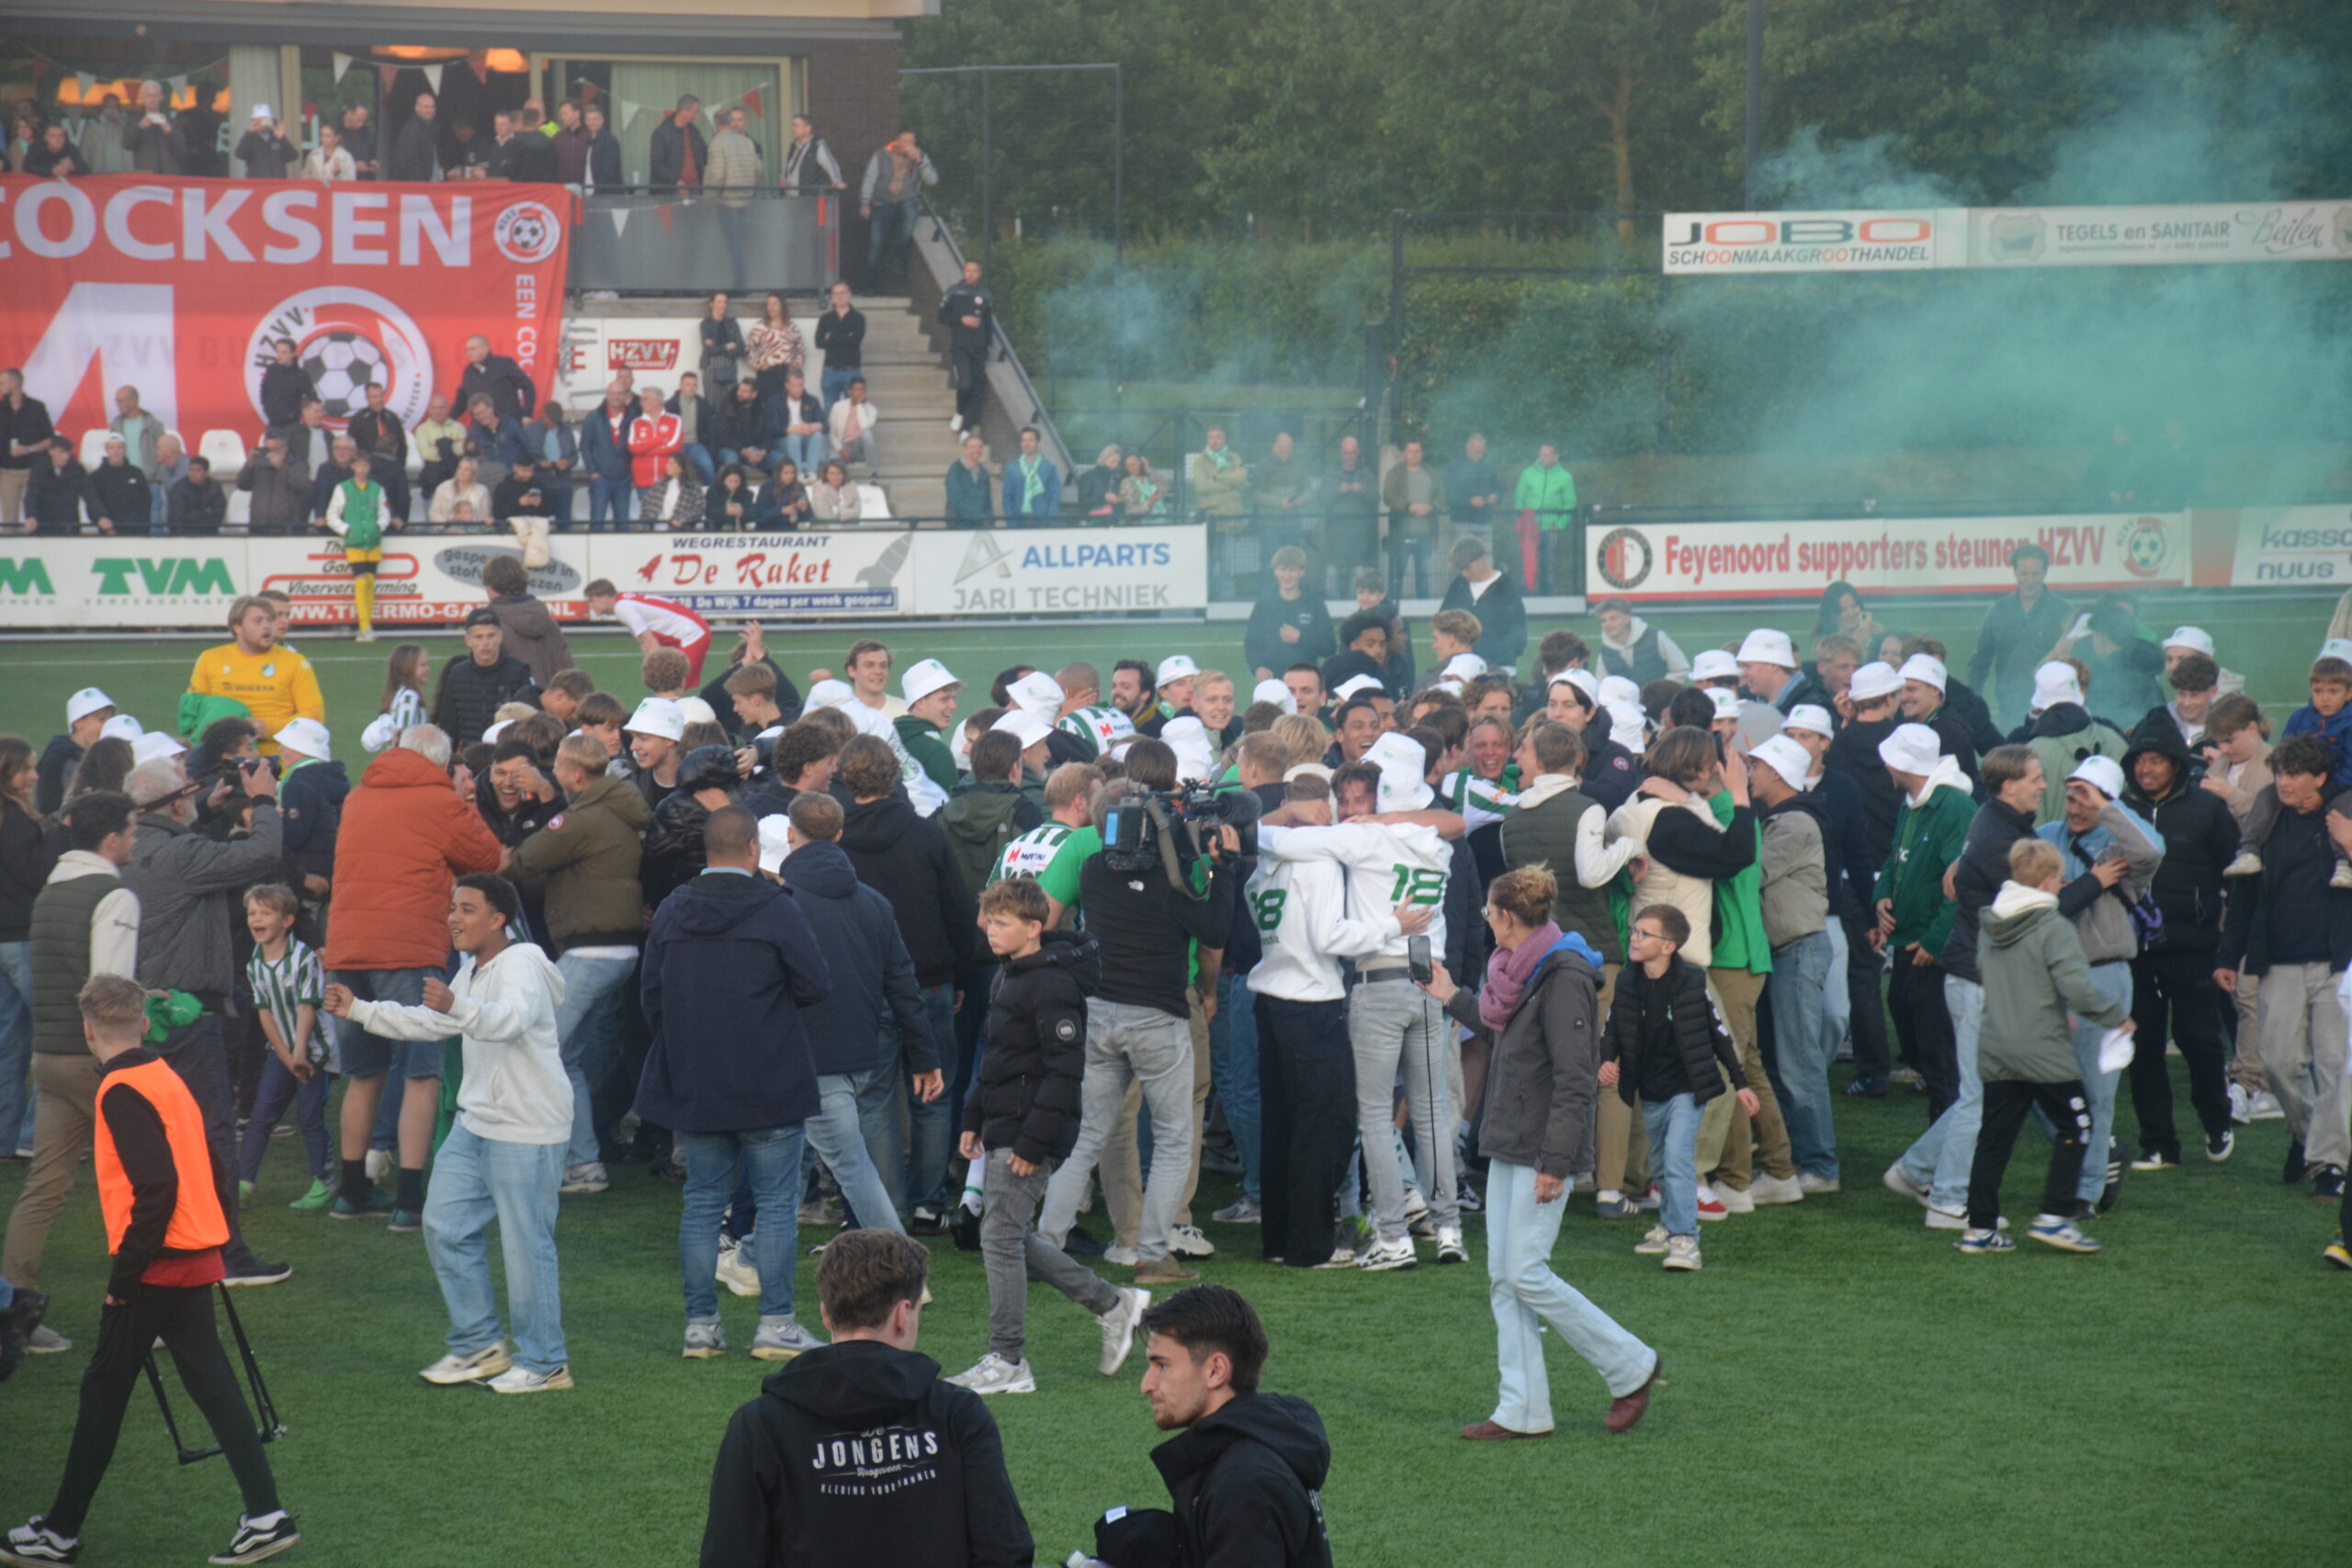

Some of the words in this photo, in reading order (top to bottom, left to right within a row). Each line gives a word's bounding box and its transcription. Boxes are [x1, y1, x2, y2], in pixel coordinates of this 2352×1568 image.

[0, 181, 472, 267] OCKSEN
[1668, 219, 1931, 246] JOBO
[2058, 223, 2118, 241] TEGELS
[2124, 225, 2146, 240] en
[2151, 220, 2230, 240] SANITAIR
[1668, 246, 1929, 265] SCHOONMAAKGROOTHANDEL
[515, 274, 536, 319] EEN
[610, 342, 672, 361] HZVV
[673, 536, 831, 549] WEGRESTAURANT
[1022, 542, 1170, 569] ALLPARTS
[1665, 533, 1791, 584] Feyenoord
[1797, 532, 1928, 581] supporters
[2037, 525, 2105, 568] HZVV
[91, 558, 237, 594] TVM
[671, 554, 718, 585] De
[736, 551, 831, 588] Raket
[2256, 560, 2335, 581] nuus
[753, 595, 787, 611] dagen
[791, 596, 809, 610] per
[812, 594, 842, 606] week
[953, 588, 1015, 610] JARI
[1026, 584, 1170, 609] TECHNIEK
[1390, 863, 1446, 905] 18
[812, 1431, 939, 1470] JONGENS
[820, 1483, 865, 1495] KLEDING
